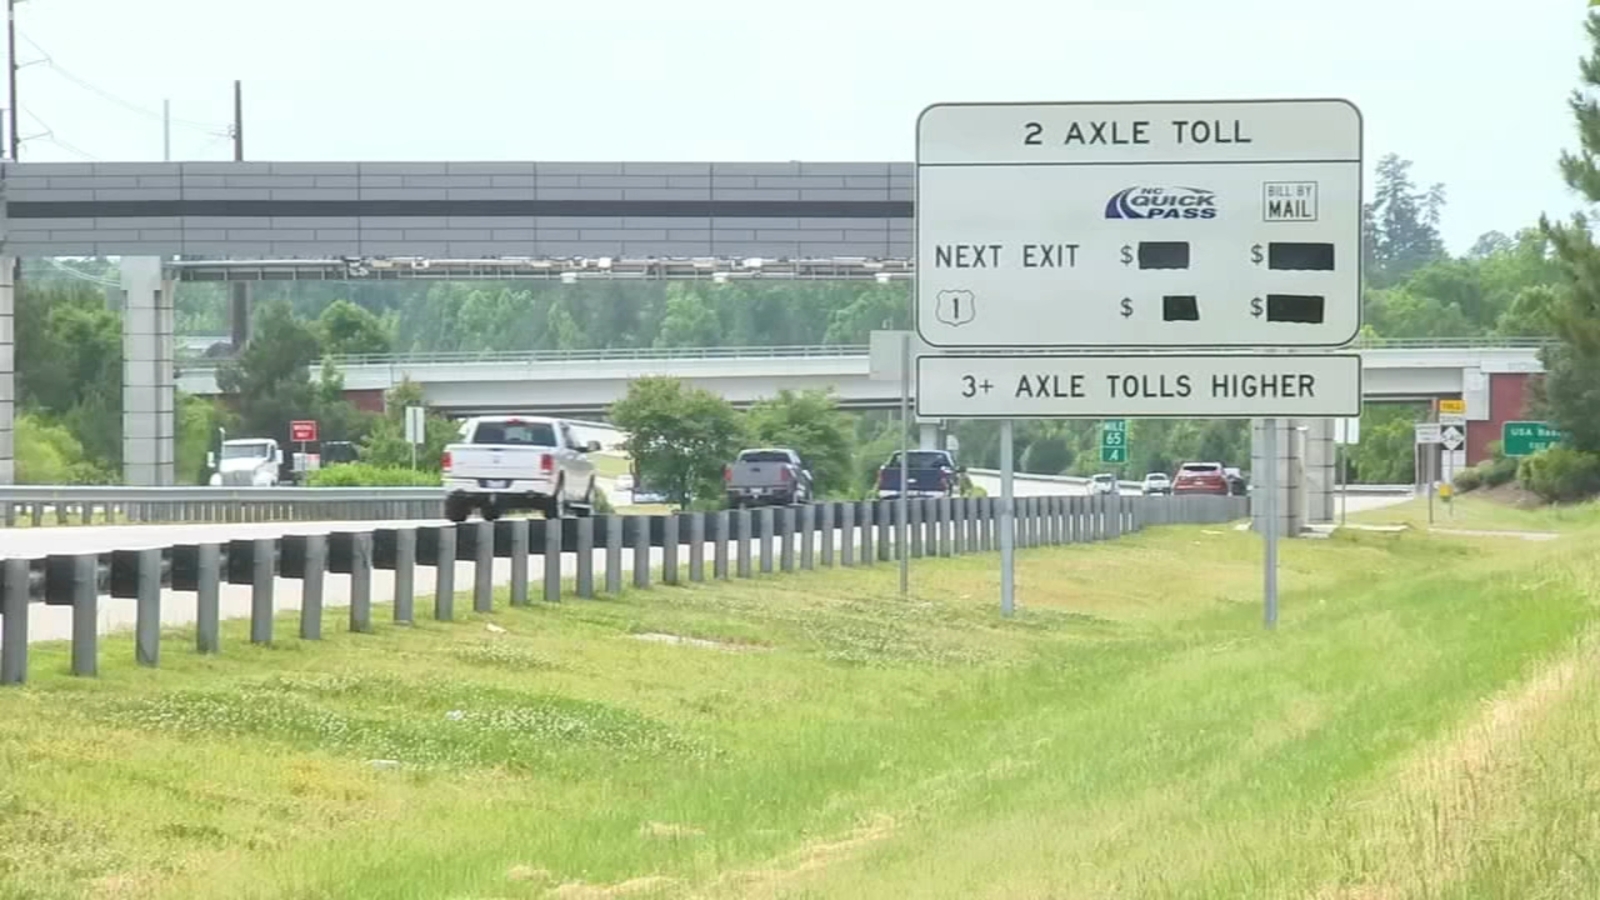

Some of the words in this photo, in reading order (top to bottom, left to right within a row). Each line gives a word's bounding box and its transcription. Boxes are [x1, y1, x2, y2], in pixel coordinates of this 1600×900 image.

[1025, 122, 1043, 146] 2
[1064, 121, 1151, 145] AXLE
[1172, 119, 1252, 144] TOLL
[1140, 187, 1164, 195] NC
[1267, 185, 1292, 197] BILL
[1297, 185, 1312, 197] BY
[1131, 194, 1216, 207] QUICK
[1146, 207, 1218, 220] PASS
[1268, 200, 1312, 219] MAIL
[935, 244, 1003, 268] NEXT
[1023, 243, 1080, 267] EXIT
[952, 297, 960, 319] 1
[961, 376, 995, 398] 3+
[1015, 375, 1085, 398] AXLE
[1106, 375, 1192, 398] TOLLS
[1212, 374, 1316, 398] HIGHER
[1106, 432, 1121, 445] 65
